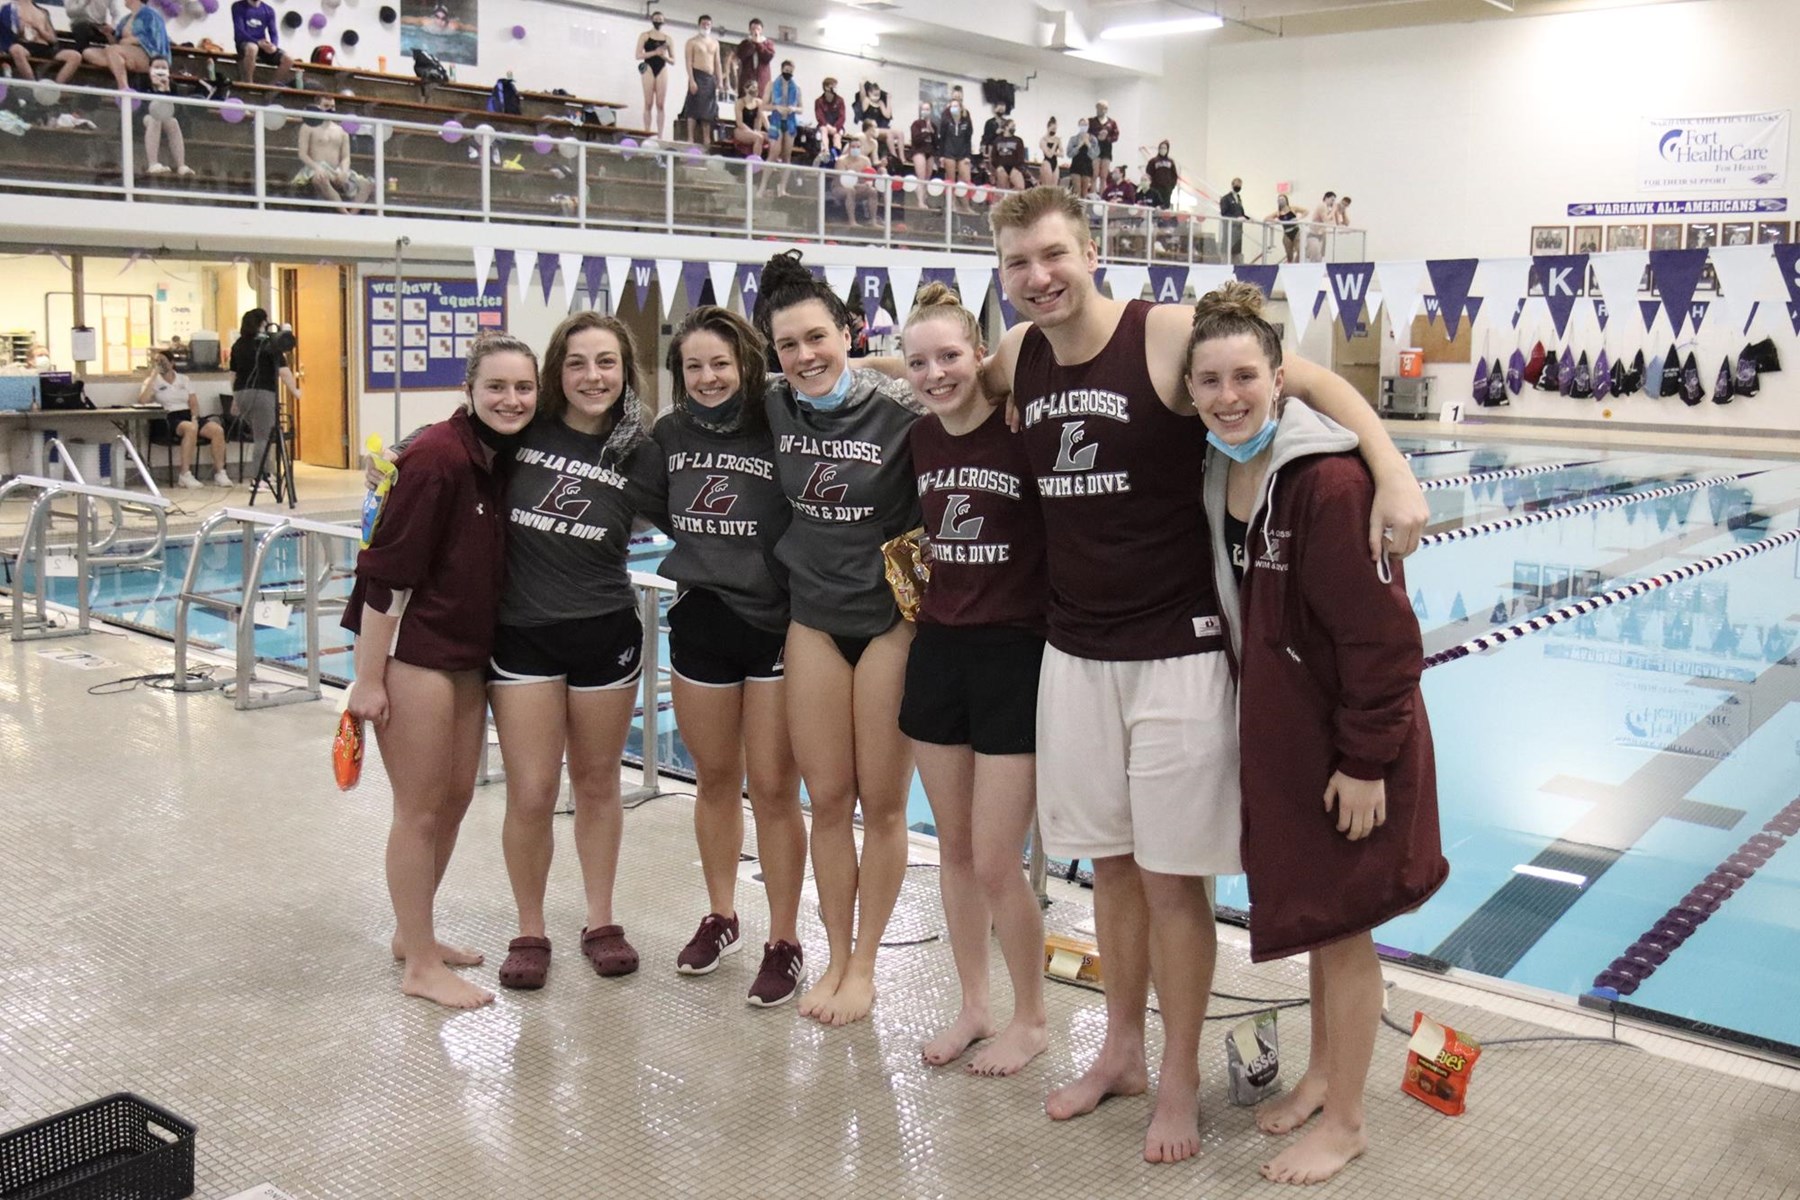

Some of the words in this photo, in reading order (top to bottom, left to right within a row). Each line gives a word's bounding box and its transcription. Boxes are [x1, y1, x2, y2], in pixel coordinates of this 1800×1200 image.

[1686, 129, 1718, 145] Fort
[1676, 144, 1769, 163] HealthCare
[1594, 202, 1655, 215] WARHAWK
[1656, 199, 1757, 214] ALL-AMERICANS
[371, 281, 442, 296] wahawk
[864, 275, 880, 298] R
[1158, 277, 1178, 301] A
[1335, 273, 1364, 300] W
[1548, 267, 1574, 297] K
[440, 295, 503, 308] aquatics
[1426, 298, 1439, 312] W
[1692, 305, 1704, 318] H
[1025, 391, 1068, 427] UW-LA
[1068, 389, 1128, 421] CROSSE
[1452, 405, 1459, 421] 1
[821, 439, 882, 465] CROSSE
[515, 447, 567, 471] UW-LA
[565, 460, 628, 490] CROSSE
[668, 452, 713, 473] UW-LA
[715, 453, 774, 480] CROSSE
[918, 468, 956, 496] W-LA
[957, 467, 1021, 499] CROSSE
[1037, 476, 1072, 497] SWIM
[1074, 475, 1085, 495] &
[1086, 471, 1130, 494] DIVE
[821, 506, 833, 520] &
[510, 508, 557, 532] SWIM
[554, 521, 568, 534] &
[568, 522, 608, 541] DIVE
[671, 513, 704, 533] SWIM
[706, 519, 717, 534] &
[718, 520, 758, 536] DIVE
[955, 544, 966, 563] &
[968, 544, 1010, 563] DIVE
